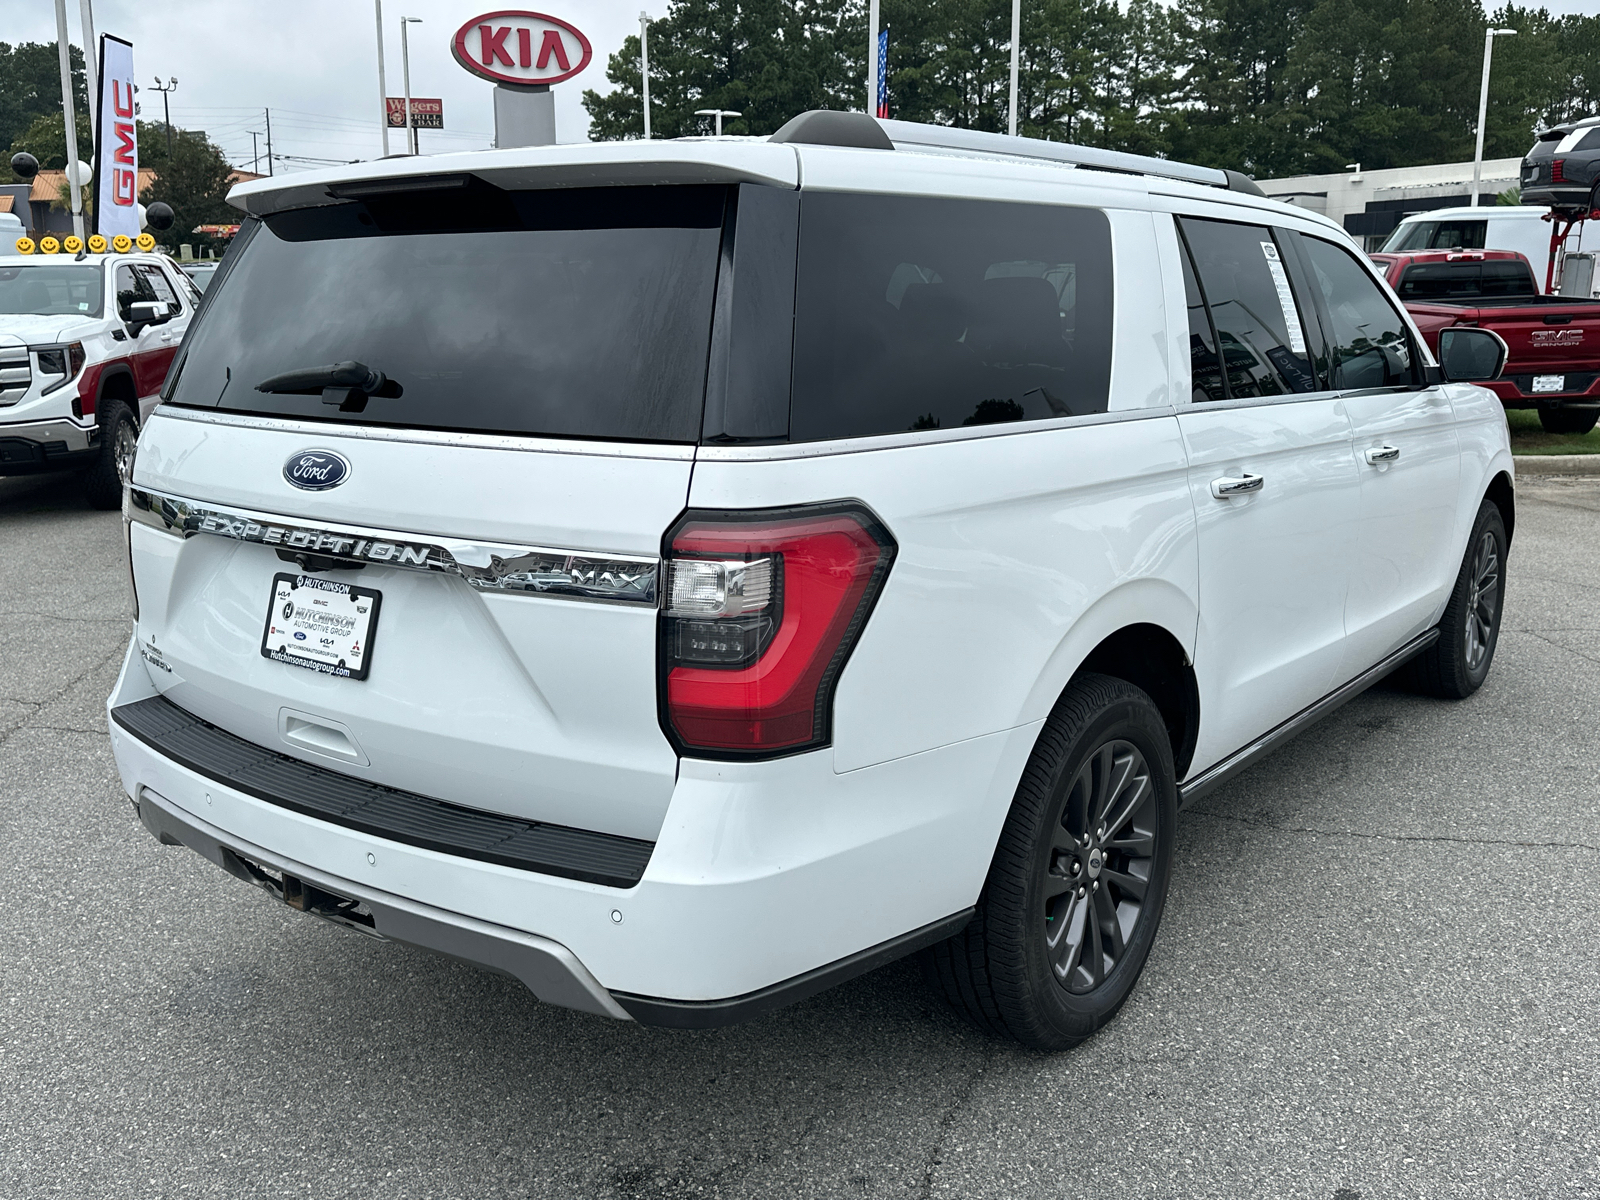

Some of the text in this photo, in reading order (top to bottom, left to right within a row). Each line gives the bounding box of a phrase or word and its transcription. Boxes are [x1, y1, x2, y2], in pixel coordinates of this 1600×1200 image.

[478, 25, 571, 70] KIA
[112, 79, 135, 207] GMC
[1532, 329, 1584, 341] GMC
[293, 456, 333, 480] Ford
[201, 515, 431, 564] EXPEDITION
[304, 576, 350, 595] HUTCHINSON
[571, 569, 643, 590] MAX
[313, 599, 329, 607] GMC
[294, 606, 357, 629] HUTCHINSON
[293, 621, 329, 633] AUTOMOTIVE
[330, 627, 351, 638] GROUP
[287, 643, 339, 659] HUTCHINSONAUTOGROUP.COM
[270, 650, 350, 677] Hutchinsonautogroup.com
